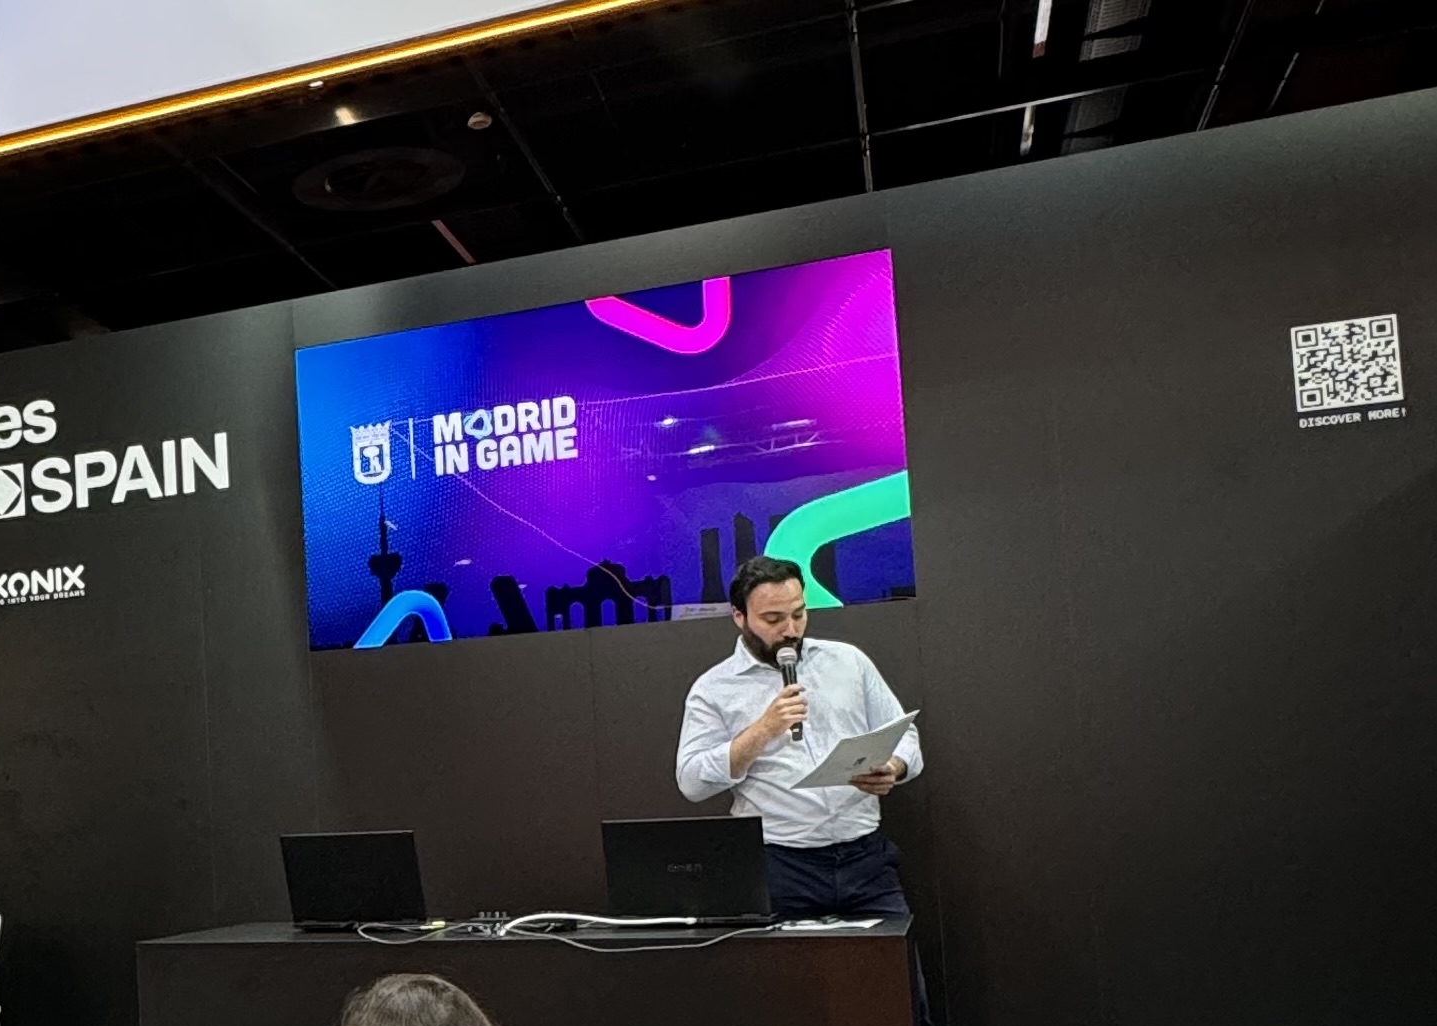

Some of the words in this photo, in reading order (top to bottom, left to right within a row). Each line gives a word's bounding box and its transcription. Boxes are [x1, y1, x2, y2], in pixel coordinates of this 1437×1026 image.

[432, 396, 576, 444] MADRID
[1299, 412, 1361, 428] DISCOVER
[1368, 407, 1406, 421] MORE!
[30, 432, 230, 513] SPAIN
[435, 444, 469, 476] IN
[476, 427, 579, 470] GAME
